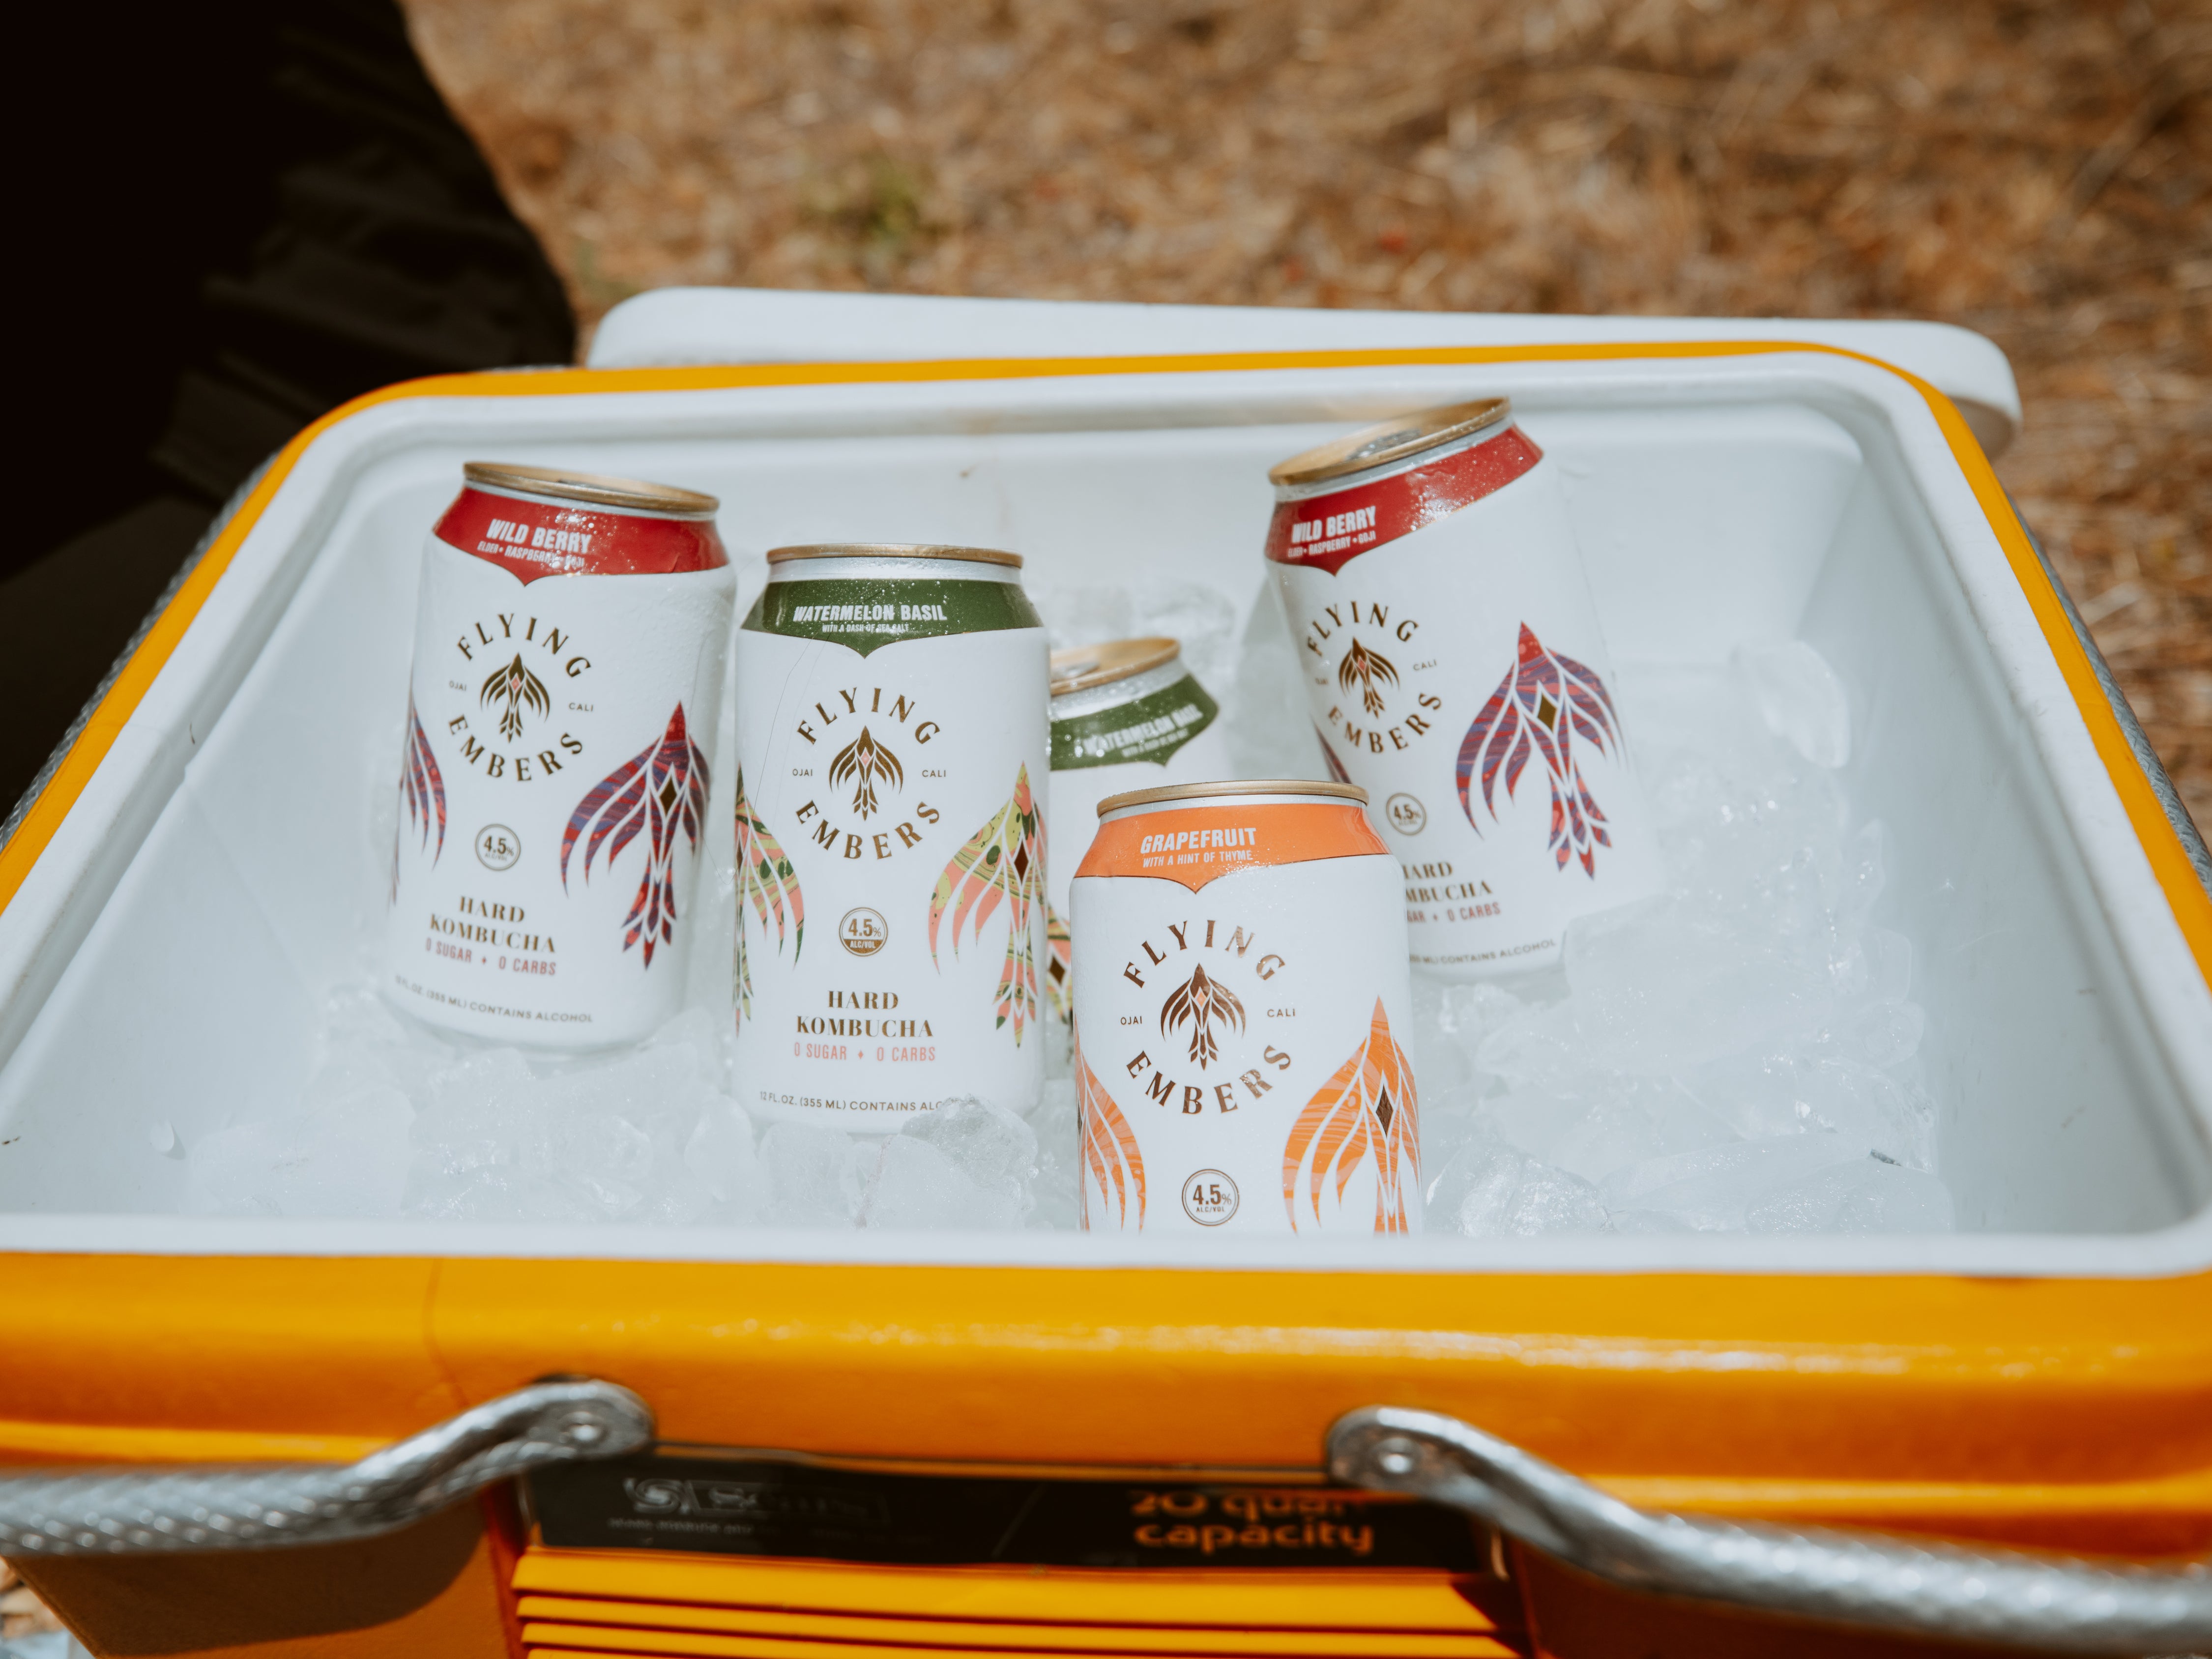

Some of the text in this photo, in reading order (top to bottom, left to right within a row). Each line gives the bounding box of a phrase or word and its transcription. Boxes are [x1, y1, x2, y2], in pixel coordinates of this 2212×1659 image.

[1292, 505, 1376, 543] WILD BERRY
[486, 519, 592, 554] WILD BERRY
[1309, 536, 1351, 555] RASPBERRY
[1358, 530, 1376, 544] GOJI
[477, 541, 499, 553] ELDER
[504, 545, 557, 564] RASPBERRY
[793, 605, 947, 622] WATERMELON BASIL
[846, 624, 864, 632] DASH
[866, 624, 875, 632] OF
[1307, 601, 1419, 657] FLYING
[457, 613, 591, 678] FLYING
[1413, 659, 1436, 670] CALI
[449, 680, 466, 692] OJAI
[569, 702, 594, 712] CALI
[797, 687, 940, 745] FLYING
[1328, 693, 1441, 754] EMBERS
[448, 715, 583, 782] EMBERS
[792, 768, 813, 777] OJAI
[795, 799, 940, 860] EMBERS
[1140, 827, 1256, 854] GRAPEFRUIT
[484, 835, 514, 856] 4.5%
[1143, 850, 1252, 868] WITH A HINT OF THYME
[1405, 880, 1492, 902] MBUCHA
[459, 896, 524, 922] HARD
[1407, 909, 1426, 923] GAR
[1459, 902, 1501, 921] CARBS
[431, 913, 555, 953] KOMBUCHA
[848, 918, 881, 937] 4.5%
[437, 941, 472, 963] SUGAR
[513, 958, 556, 975] CARBS
[1124, 920, 1285, 989] FLYING
[1441, 951, 1496, 963] CONTAINS
[1500, 938, 1556, 958] ALCOHOL
[827, 990, 899, 1009] HARD
[470, 1002, 531, 1019] CONTAINS
[535, 1013, 593, 1023] ALCOHOL
[1120, 1016, 1142, 1025] OJAI
[1267, 1009, 1296, 1018] CALI
[797, 1015, 933, 1037] KOMBUCHA
[794, 1042, 936, 1062] 0 SUGAR 0 CARBS
[1127, 1045, 1290, 1114] EMBERS
[760, 1091, 767, 1101] 12
[800, 1097, 822, 1107] (355
[826, 1099, 846, 1110] ML)
[850, 1101, 916, 1111] CONTAINS
[1193, 1184, 1232, 1205] 4.5%
[1222, 1492, 1364, 1522] quar
[1134, 1516, 1374, 1555] capacity
